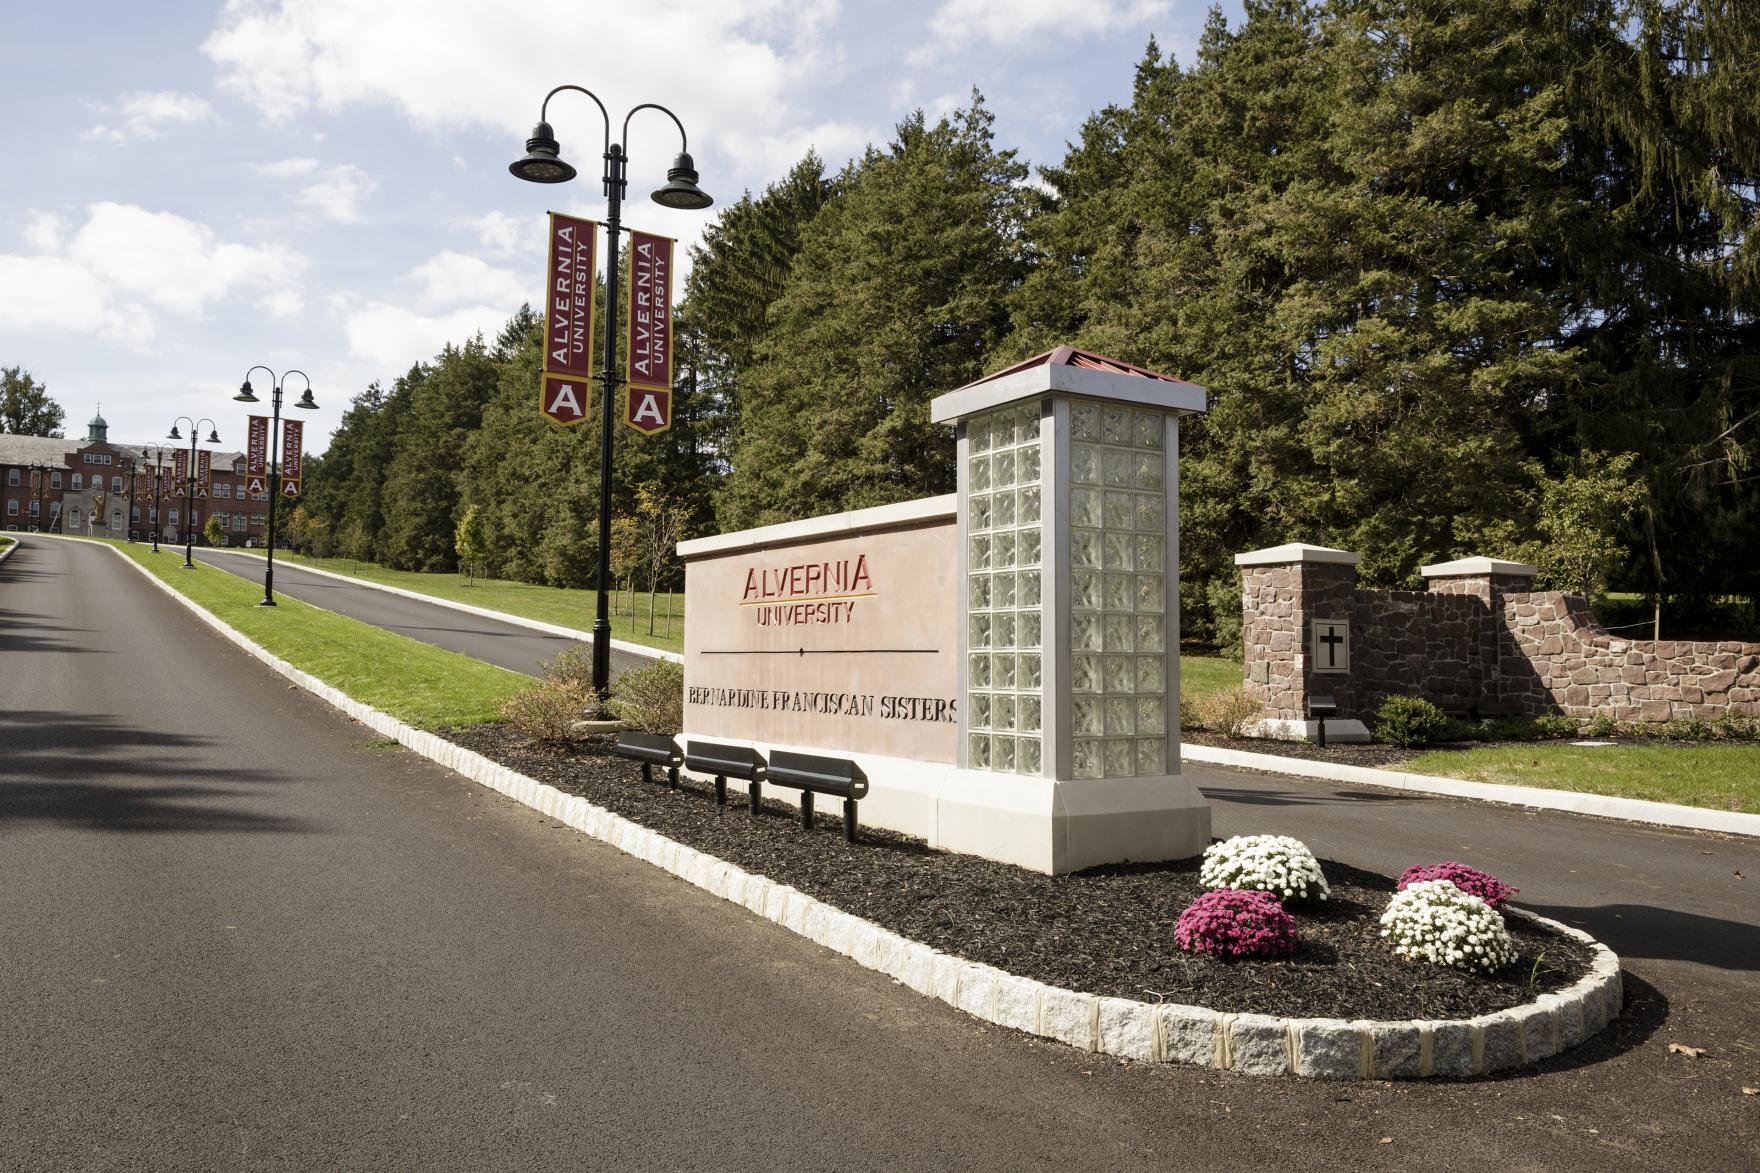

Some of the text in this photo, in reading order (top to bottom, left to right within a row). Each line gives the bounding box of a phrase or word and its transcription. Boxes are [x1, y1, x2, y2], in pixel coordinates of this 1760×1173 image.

[552, 226, 573, 365] ALVERNIA
[573, 241, 588, 353] UNIVERSITY
[635, 242, 652, 376] ALVERNIA
[654, 256, 665, 364] UNIVERSITY
[548, 384, 582, 416] A
[633, 394, 665, 425] A
[249, 419, 259, 472] ALVERNIA
[284, 423, 294, 475] ALVERNIA
[176, 488, 185, 496] A
[198, 488, 208, 496] A
[248, 478, 263, 491] A
[284, 482, 298, 494] A
[743, 553, 874, 601] ALVERNIA
[757, 601, 855, 627] UNIVERSITY
[688, 686, 769, 710] BERNARDINE
[772, 690, 874, 717] FRANCISCAN
